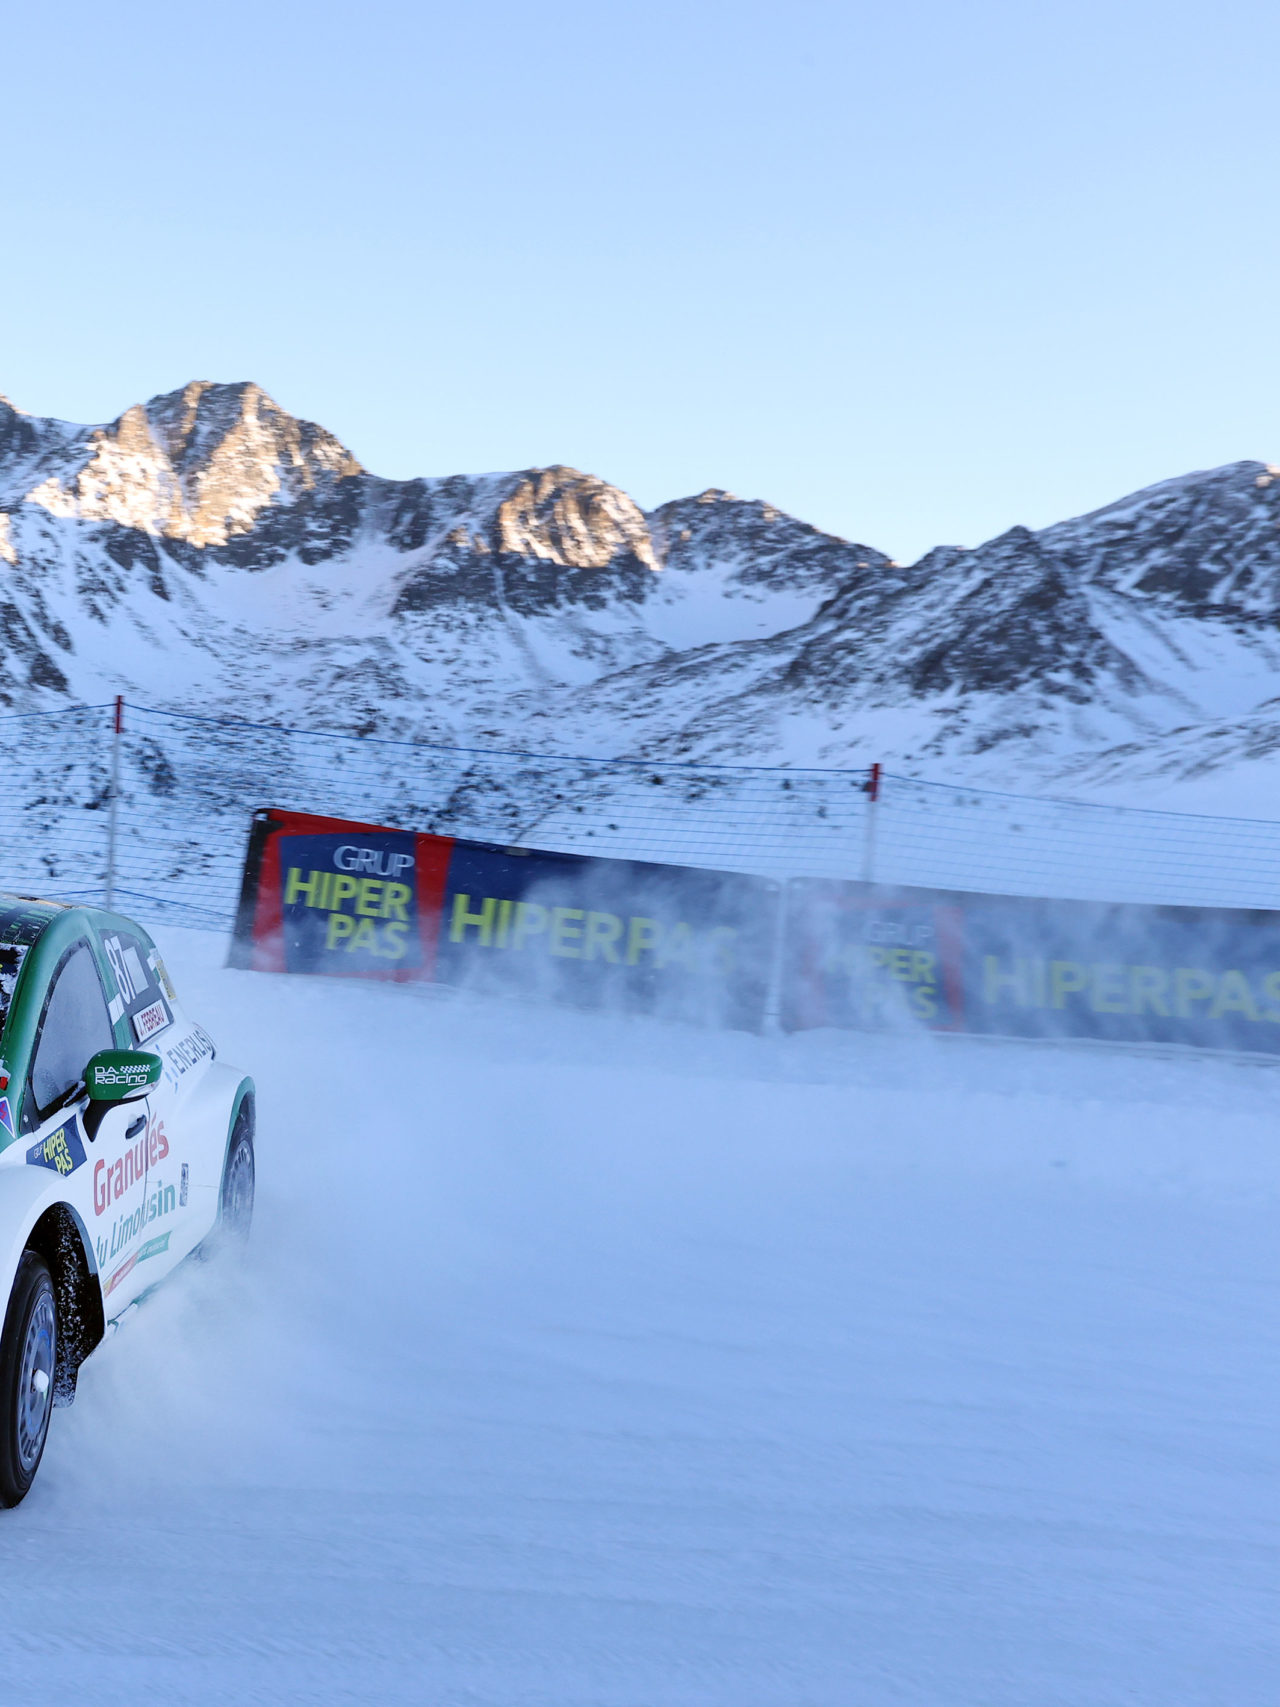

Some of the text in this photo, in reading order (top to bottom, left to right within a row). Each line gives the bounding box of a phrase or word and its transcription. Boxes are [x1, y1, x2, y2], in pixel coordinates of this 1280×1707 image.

[333, 845, 415, 876] GRUP
[284, 868, 412, 921] HIPER
[326, 913, 410, 960] PAS
[43, 1128, 68, 1163] HIPER
[54, 1147, 74, 1175] PAS
[93, 1112, 170, 1217] Granulés
[110, 1180, 176, 1260] Limousin
